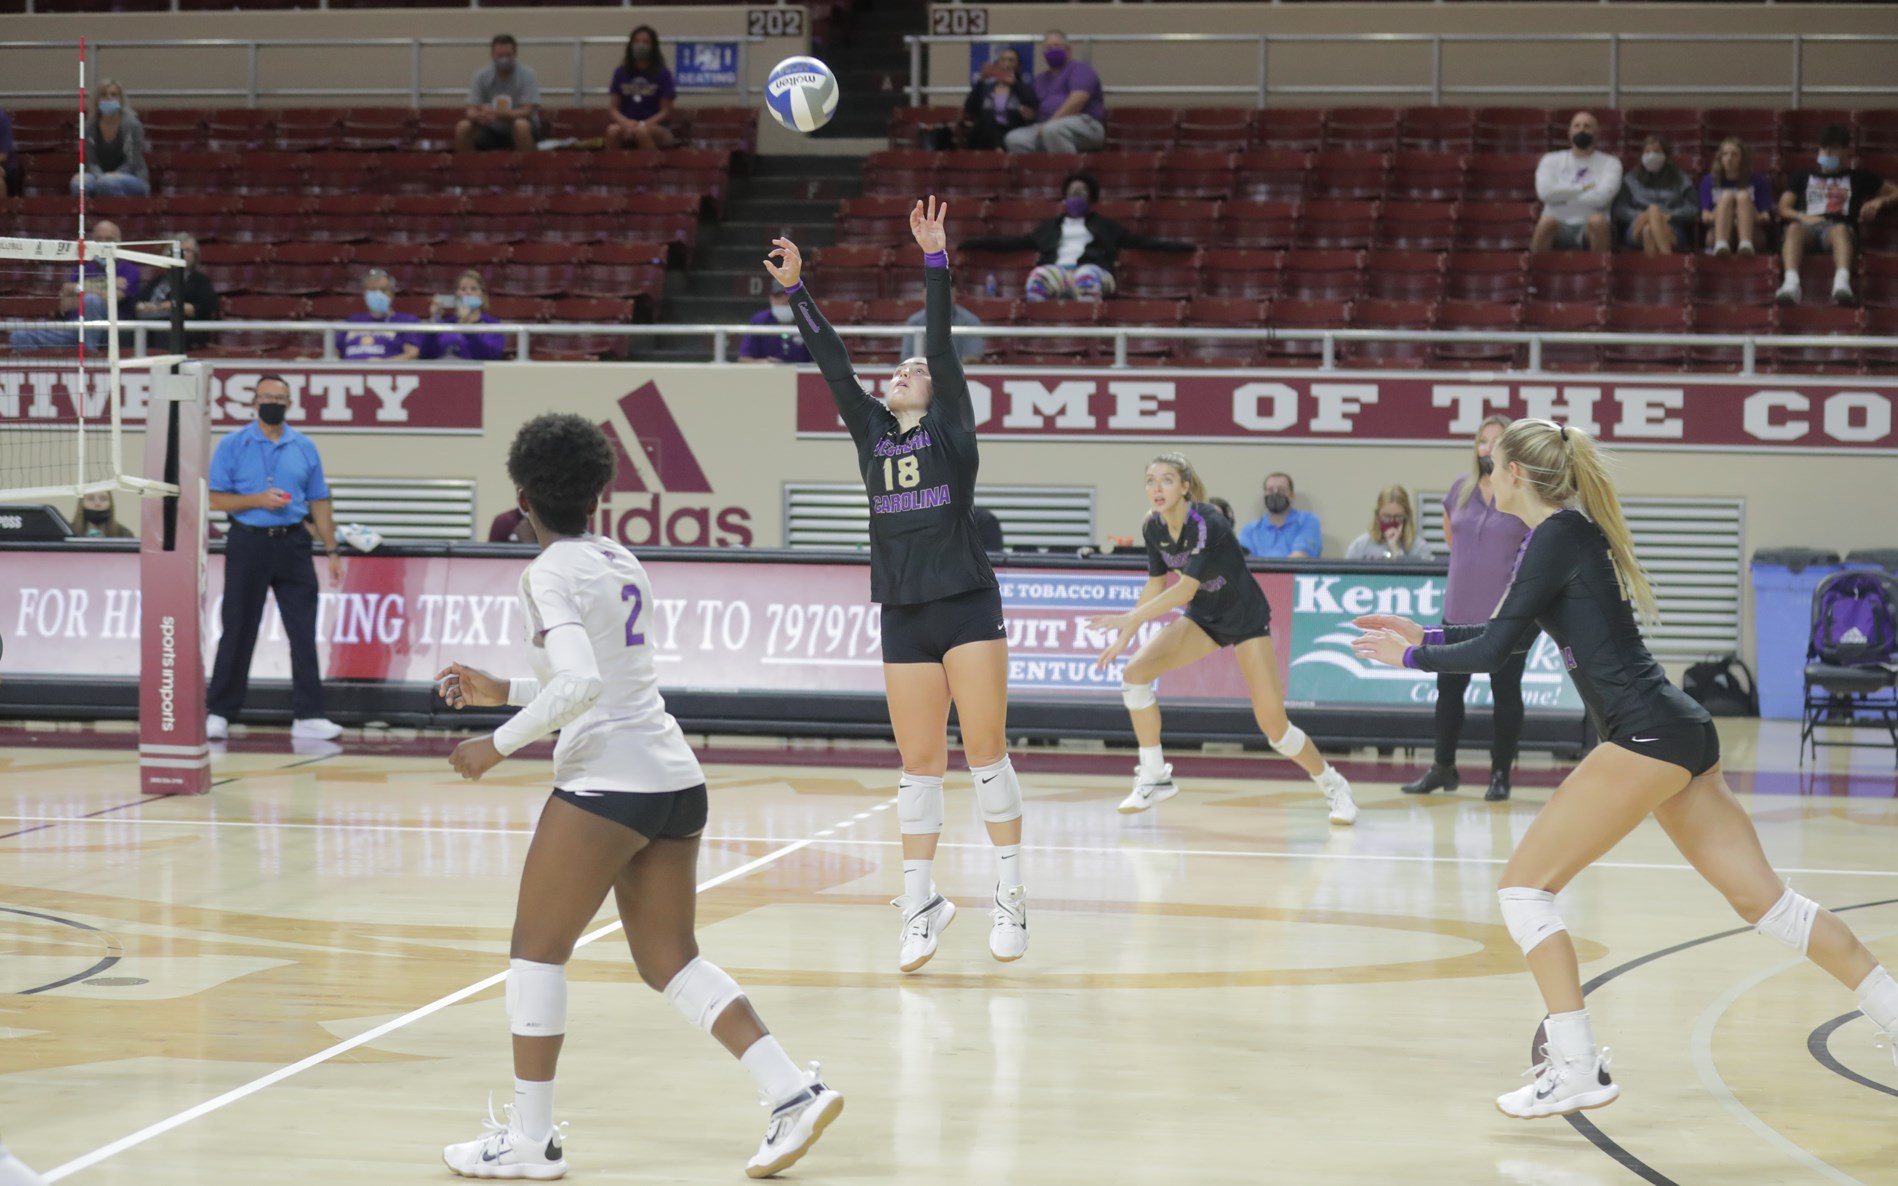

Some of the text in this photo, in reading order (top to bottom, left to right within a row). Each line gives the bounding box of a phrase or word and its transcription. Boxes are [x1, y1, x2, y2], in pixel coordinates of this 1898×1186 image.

[750, 11, 800, 34] 202
[935, 10, 985, 33] 203
[678, 72, 737, 84] SEATING
[775, 74, 816, 88] molten
[1232, 382, 1379, 433] OF
[1432, 384, 1684, 437] THE
[1743, 390, 1891, 441] CO
[883, 454, 921, 491] 18
[873, 484, 951, 514] CAROLINA
[1018, 584, 1105, 599] TOBACCO
[1294, 576, 1444, 615] Kent
[15, 588, 89, 637] FOR
[417, 594, 518, 645] TEXT
[696, 600, 751, 650] TO
[765, 603, 882, 656] 797979
[620, 583, 645, 647] 2
[1005, 618, 1067, 648] UIT
[159, 616, 177, 732] sports imports
[1008, 660, 1124, 682] ENTUCK
